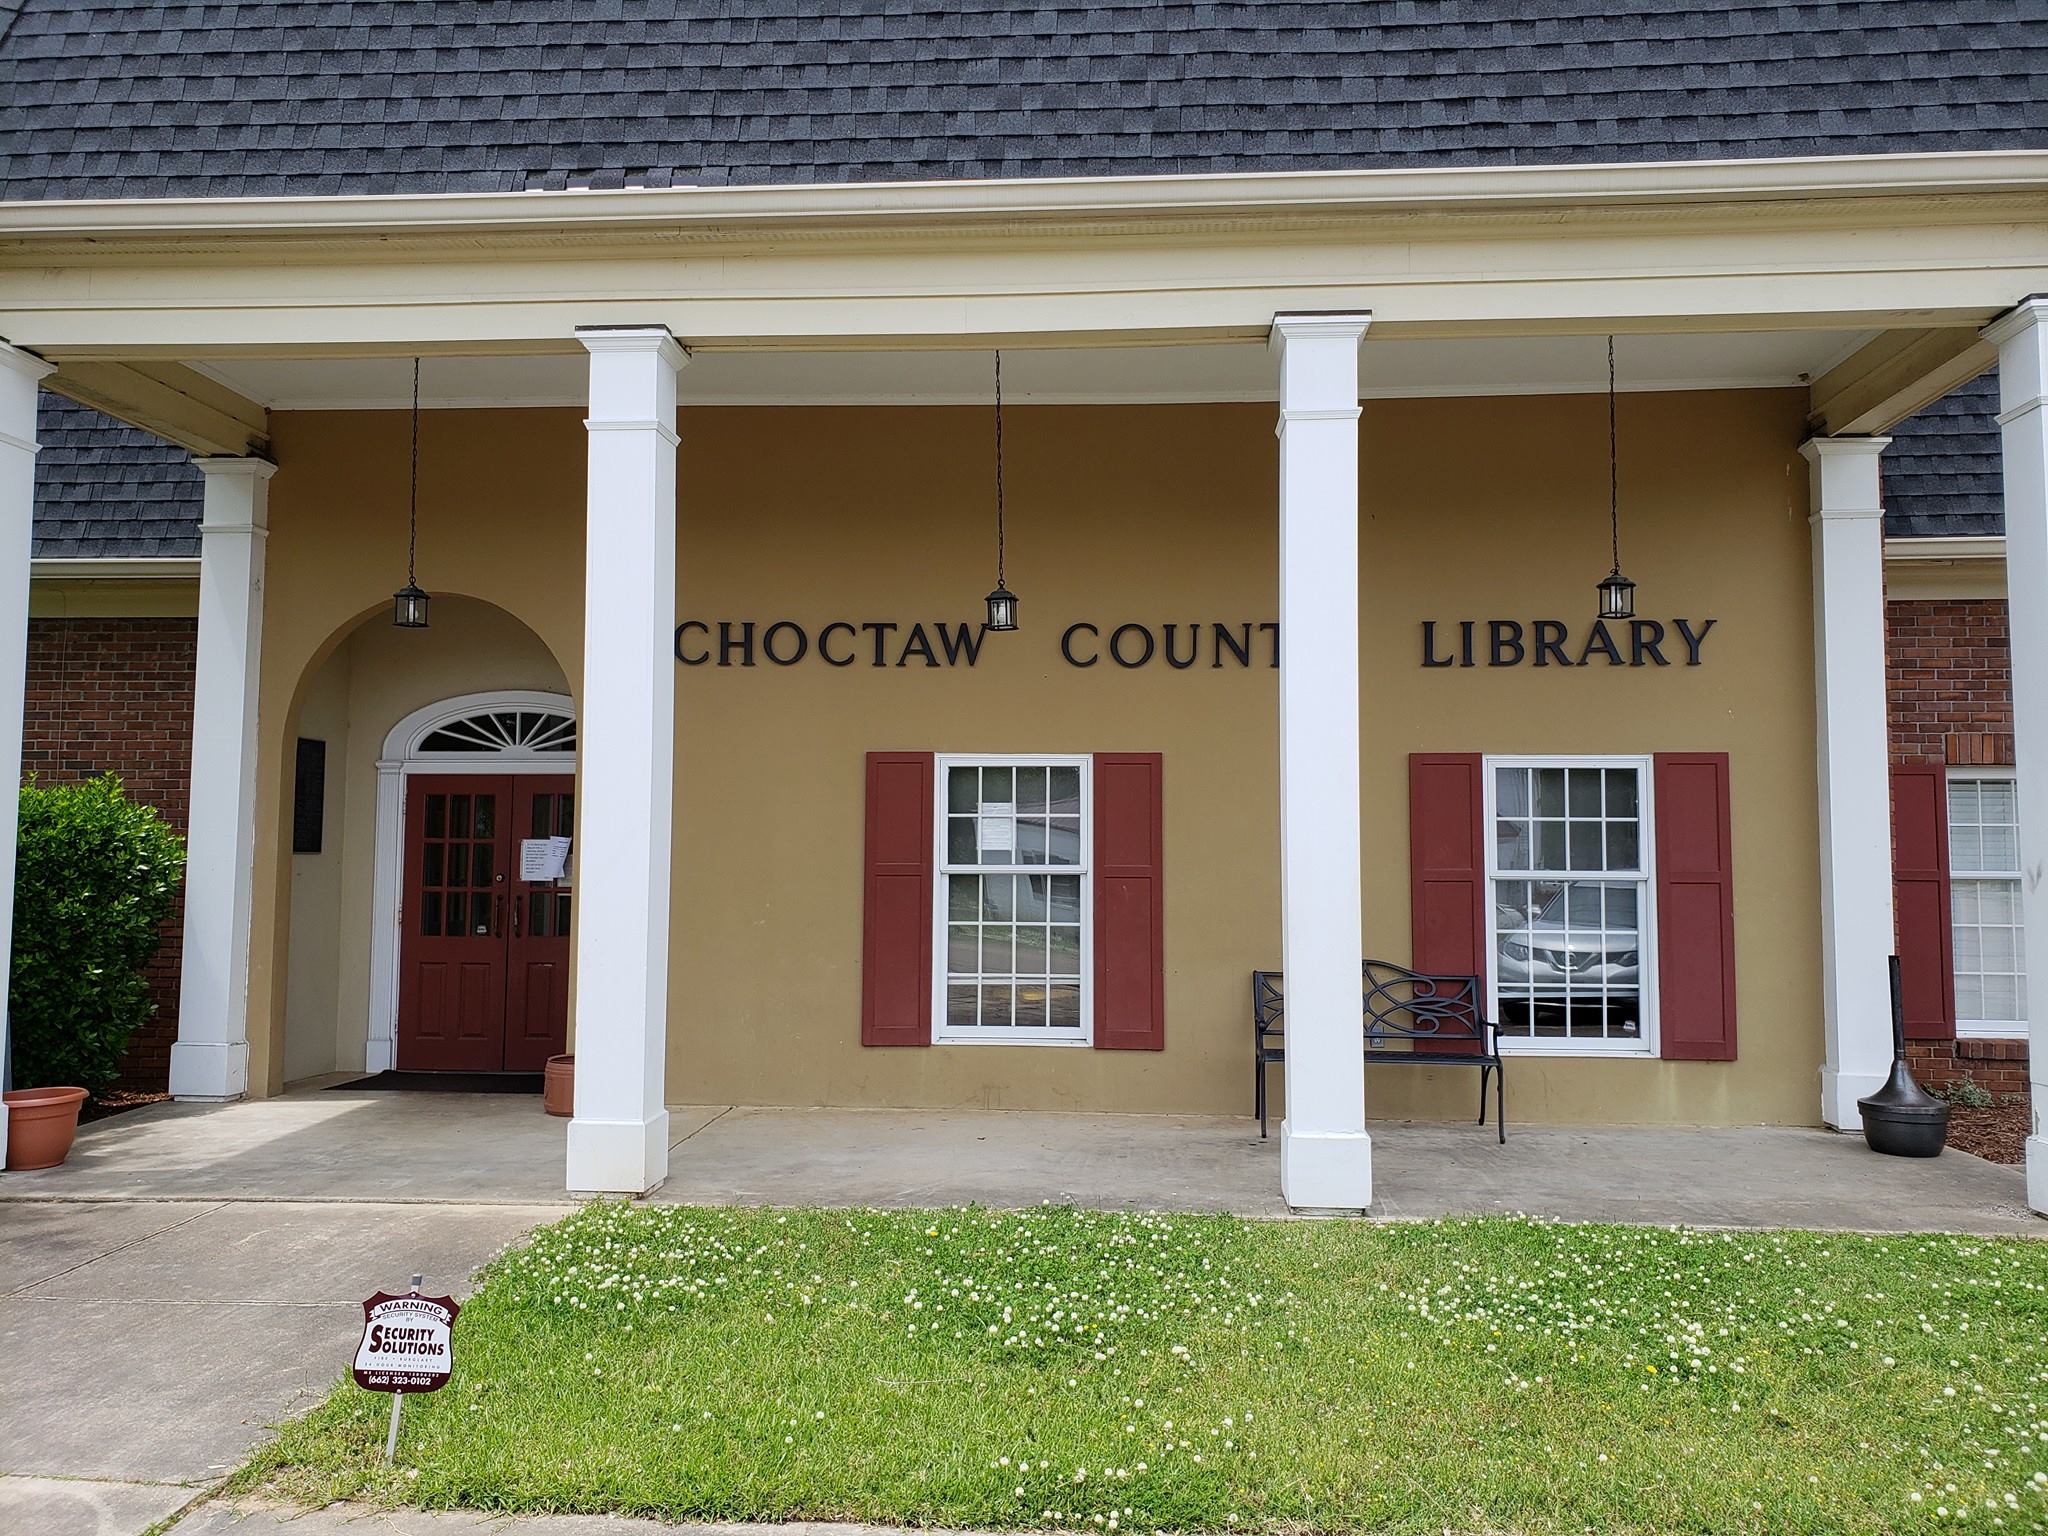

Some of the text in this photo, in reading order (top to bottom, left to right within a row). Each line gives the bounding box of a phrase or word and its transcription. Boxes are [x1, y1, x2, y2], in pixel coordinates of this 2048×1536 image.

[675, 618, 1718, 668] CHOCTAW COUNT LIBRARY
[380, 1301, 443, 1315] WARNING
[382, 1311, 439, 1322] SECURITY SYSTEM
[368, 1325, 435, 1347] SECURITY
[368, 1339, 445, 1356] SOLUTIONS
[368, 1375, 432, 1386] (662) 323-0102
